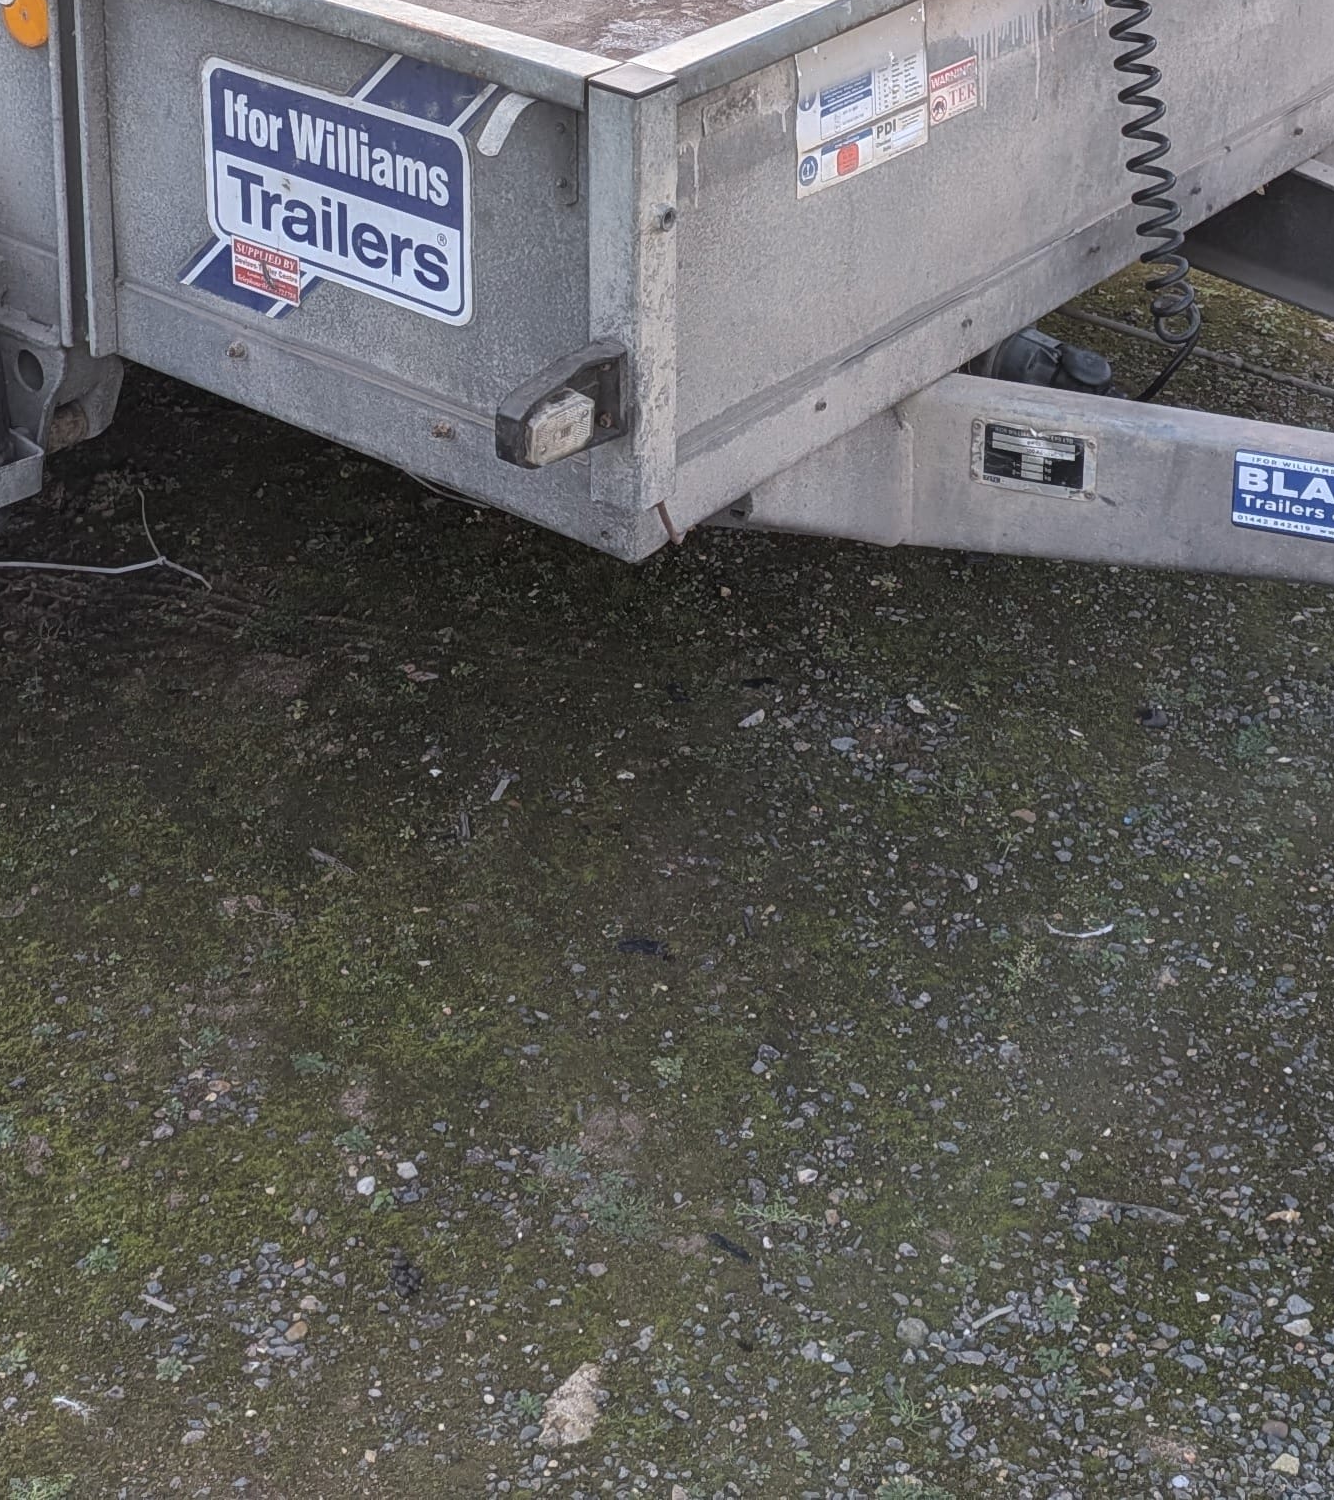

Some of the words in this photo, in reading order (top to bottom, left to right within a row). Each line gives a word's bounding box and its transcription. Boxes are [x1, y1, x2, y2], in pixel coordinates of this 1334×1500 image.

[876, 118, 896, 139] PDI
[223, 88, 283, 152] Ifor
[288, 108, 450, 207] Williams
[227, 164, 450, 292] Trailers
[235, 242, 281, 266] SUPPLIED
[283, 260, 296, 271] BY
[1251, 456, 1277, 466] IFOR
[1241, 493, 1325, 519] Trailers
[1237, 514, 1269, 525] 01442
